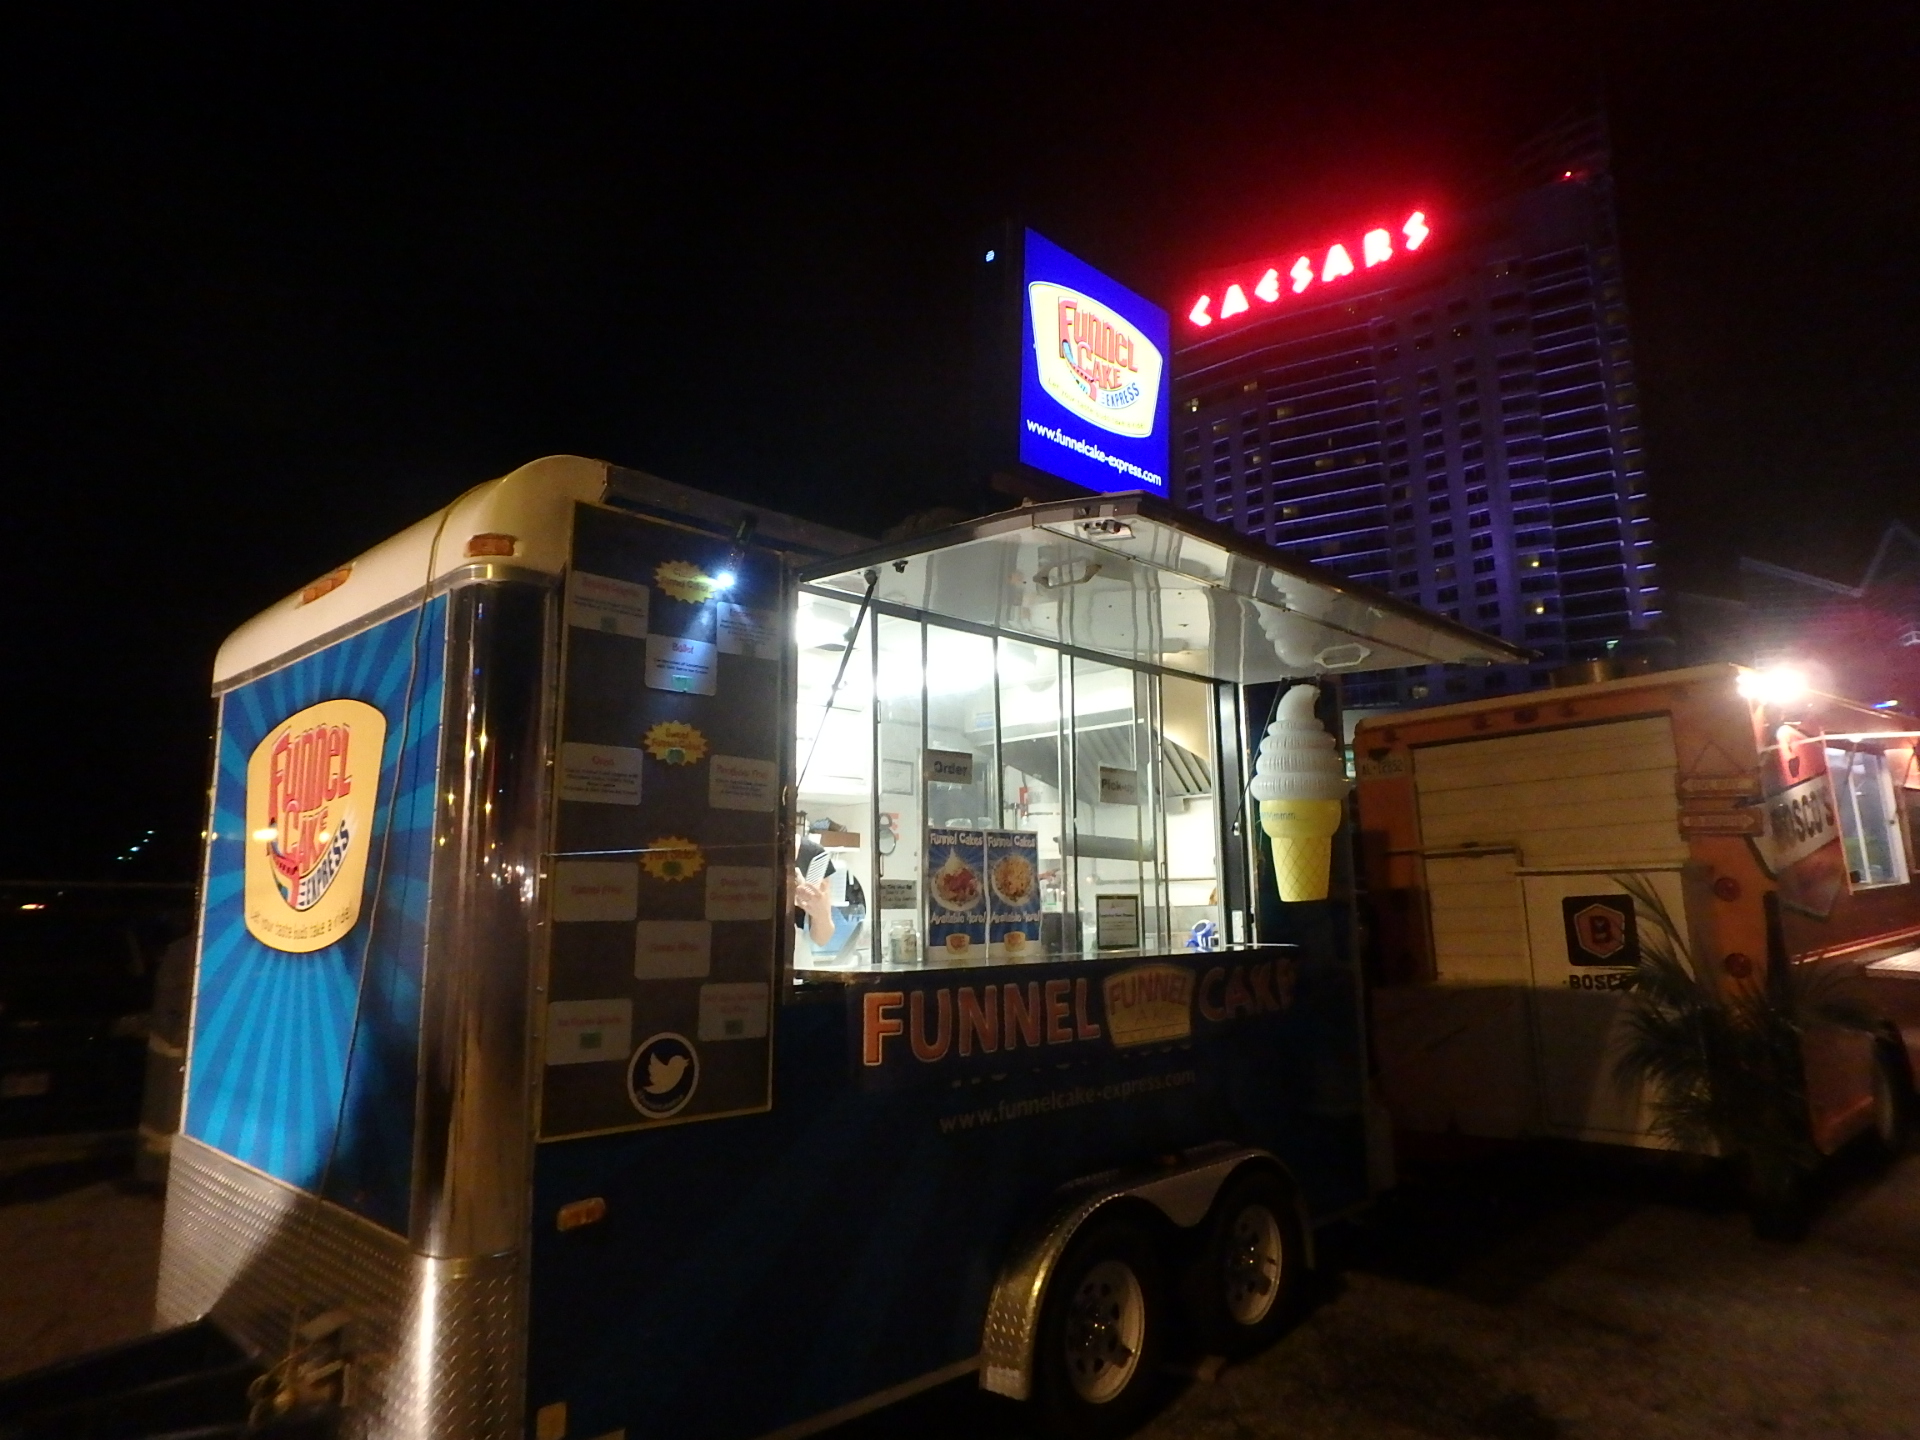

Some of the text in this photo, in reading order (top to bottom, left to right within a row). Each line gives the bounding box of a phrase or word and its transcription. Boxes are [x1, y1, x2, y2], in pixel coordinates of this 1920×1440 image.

[1189, 211, 1430, 327] CAESARS
[1106, 381, 1141, 407] EXPRESS
[1027, 419, 1162, 486] www.funnelcake-express.com
[933, 760, 968, 777] Order
[1101, 778, 1135, 795] Pick-up
[930, 832, 983, 846] Funnel Cakes
[1013, 835, 1036, 848] Cakes
[305, 819, 350, 907] EXPRESS
[1109, 970, 1189, 1016] FUNNEL
[863, 976, 1100, 1066] FUNNEL
[937, 1067, 1197, 1136] www.funnelcake-express.com
